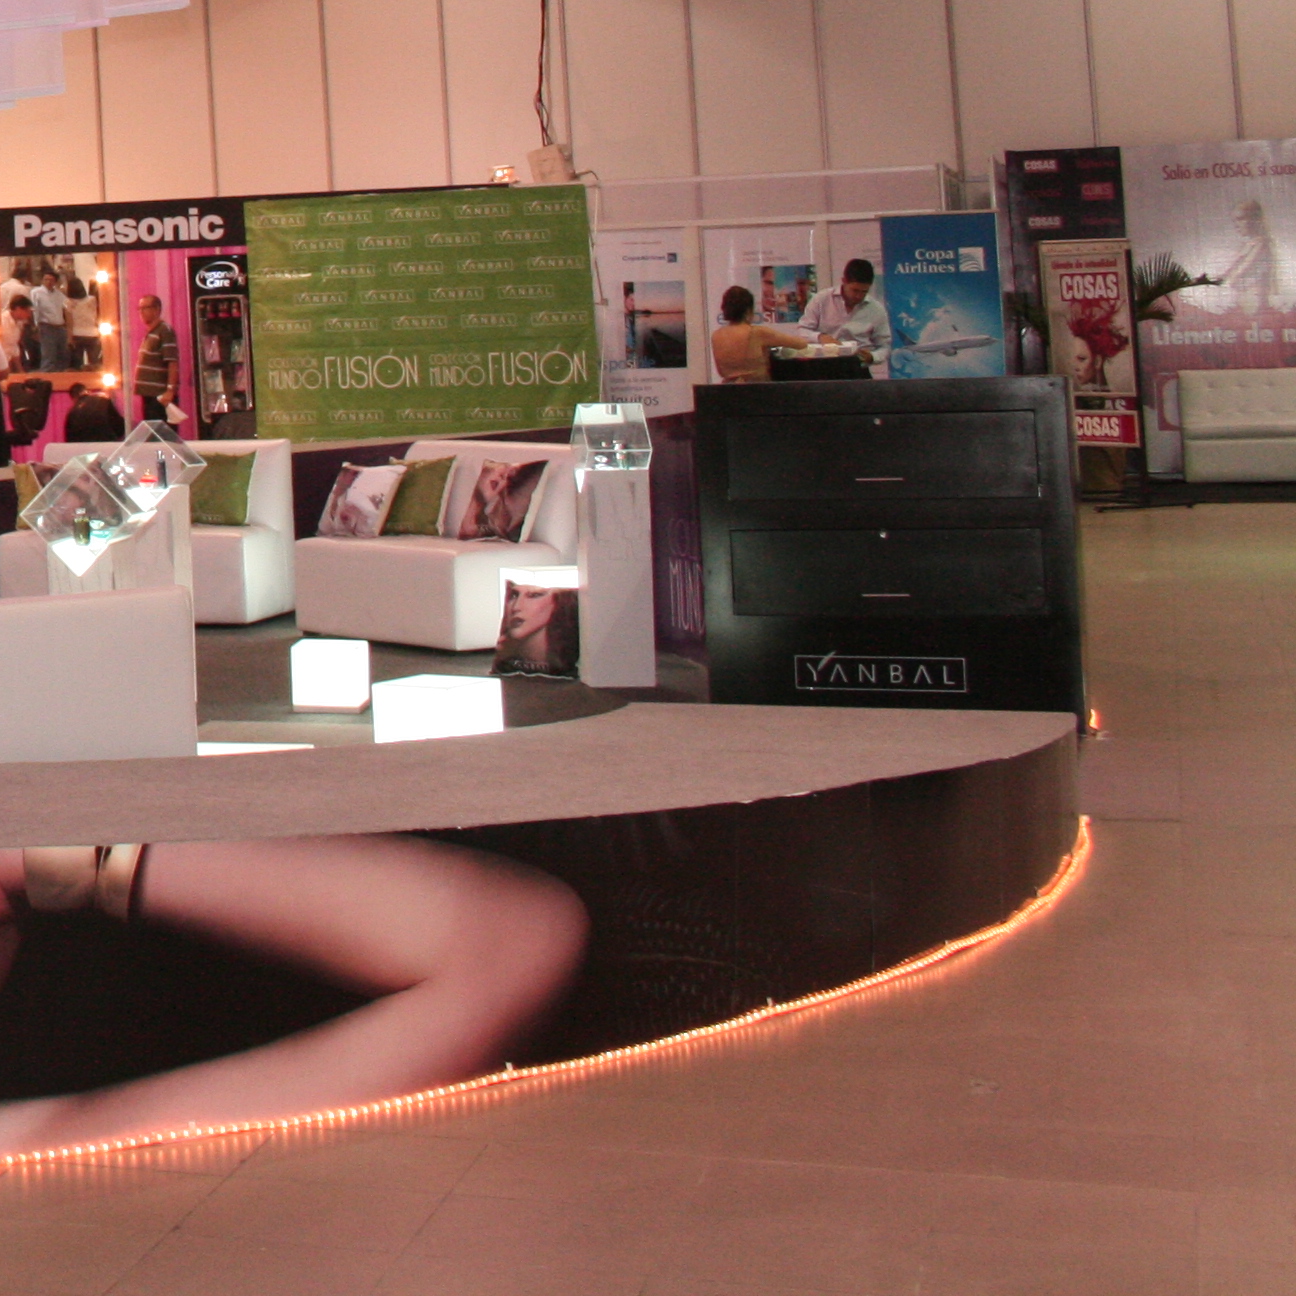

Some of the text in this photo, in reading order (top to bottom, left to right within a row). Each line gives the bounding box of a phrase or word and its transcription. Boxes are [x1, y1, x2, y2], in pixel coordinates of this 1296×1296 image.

[13, 207, 225, 248] Panasonic
[894, 261, 956, 274] Airlines
[914, 248, 955, 262] Copa
[206, 277, 231, 288] Care
[1060, 273, 1119, 300] COSAS
[268, 348, 420, 390] MUNDO FUSIÓN
[429, 343, 589, 387] MUNDO FUSIÓN
[1075, 416, 1120, 437] COSAS
[806, 650, 956, 686] YANBAL
